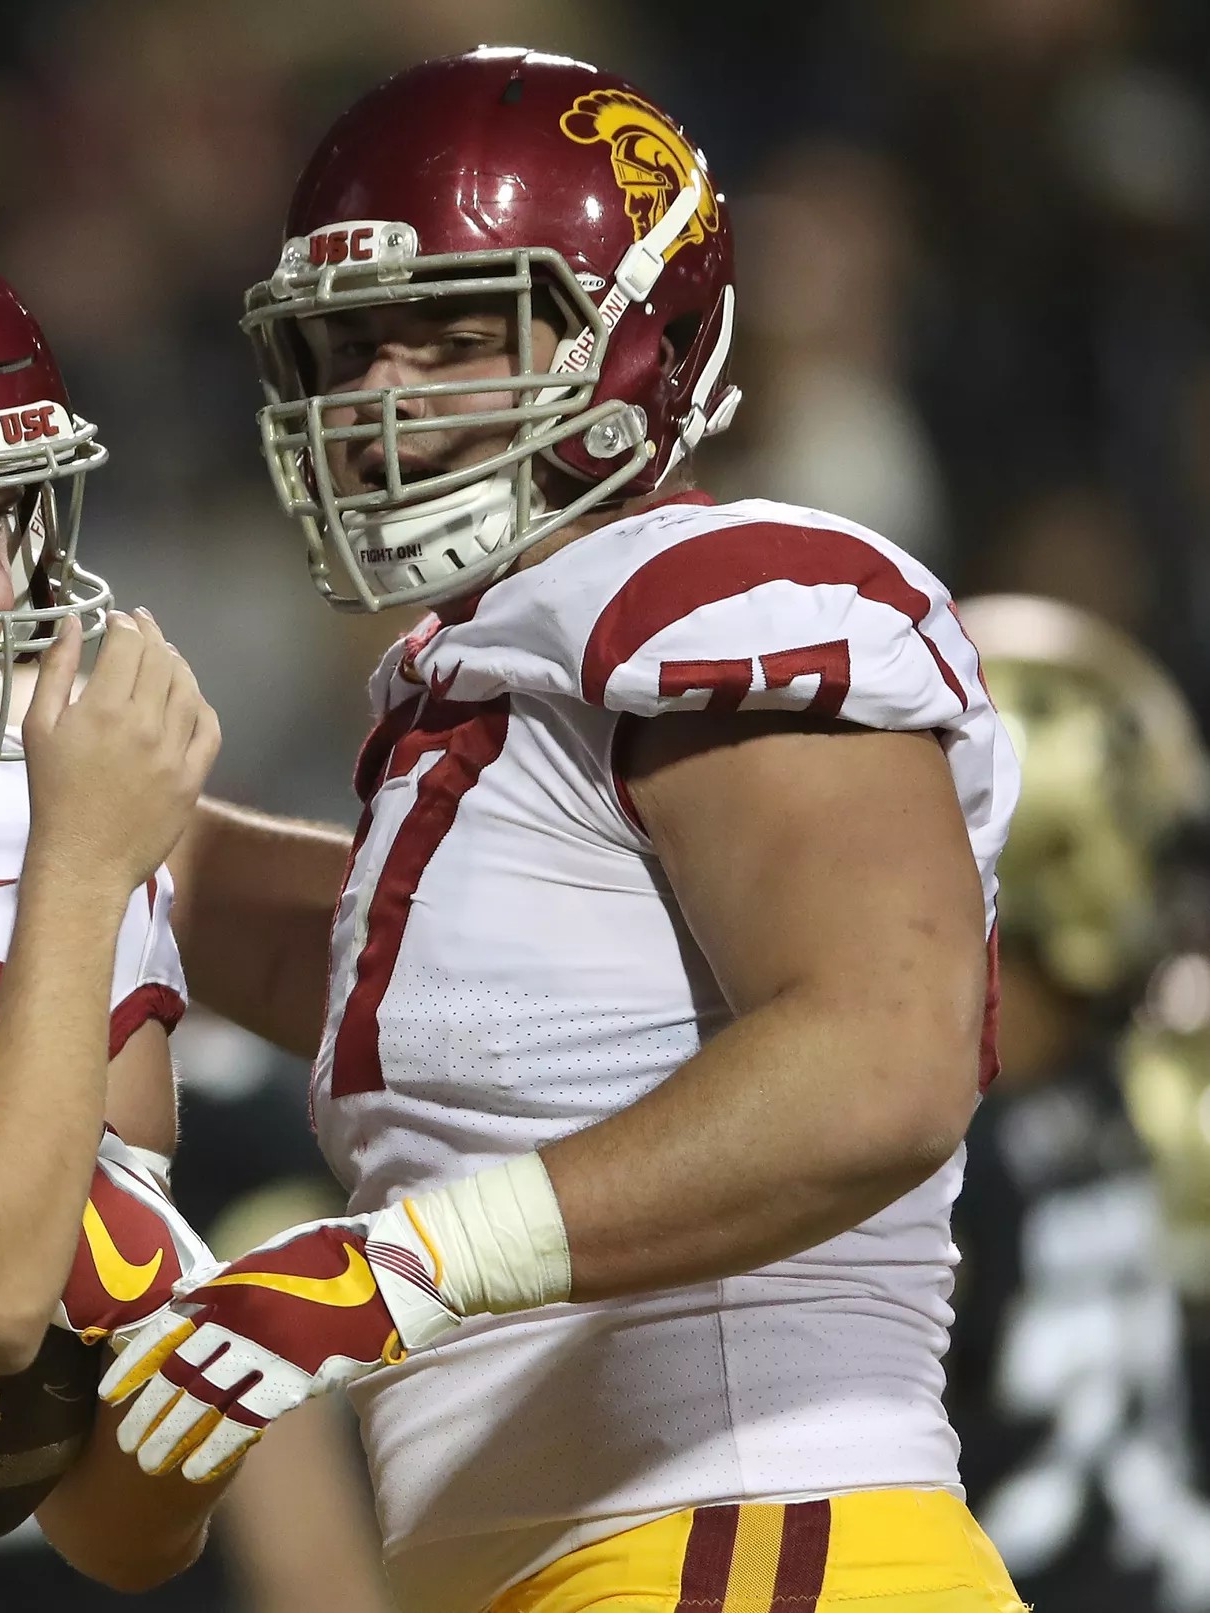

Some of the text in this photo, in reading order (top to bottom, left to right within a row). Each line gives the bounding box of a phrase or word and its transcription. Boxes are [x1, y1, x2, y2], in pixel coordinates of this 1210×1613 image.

[309, 227, 374, 266] USC
[360, 543, 423, 563] FIGHT ON!
